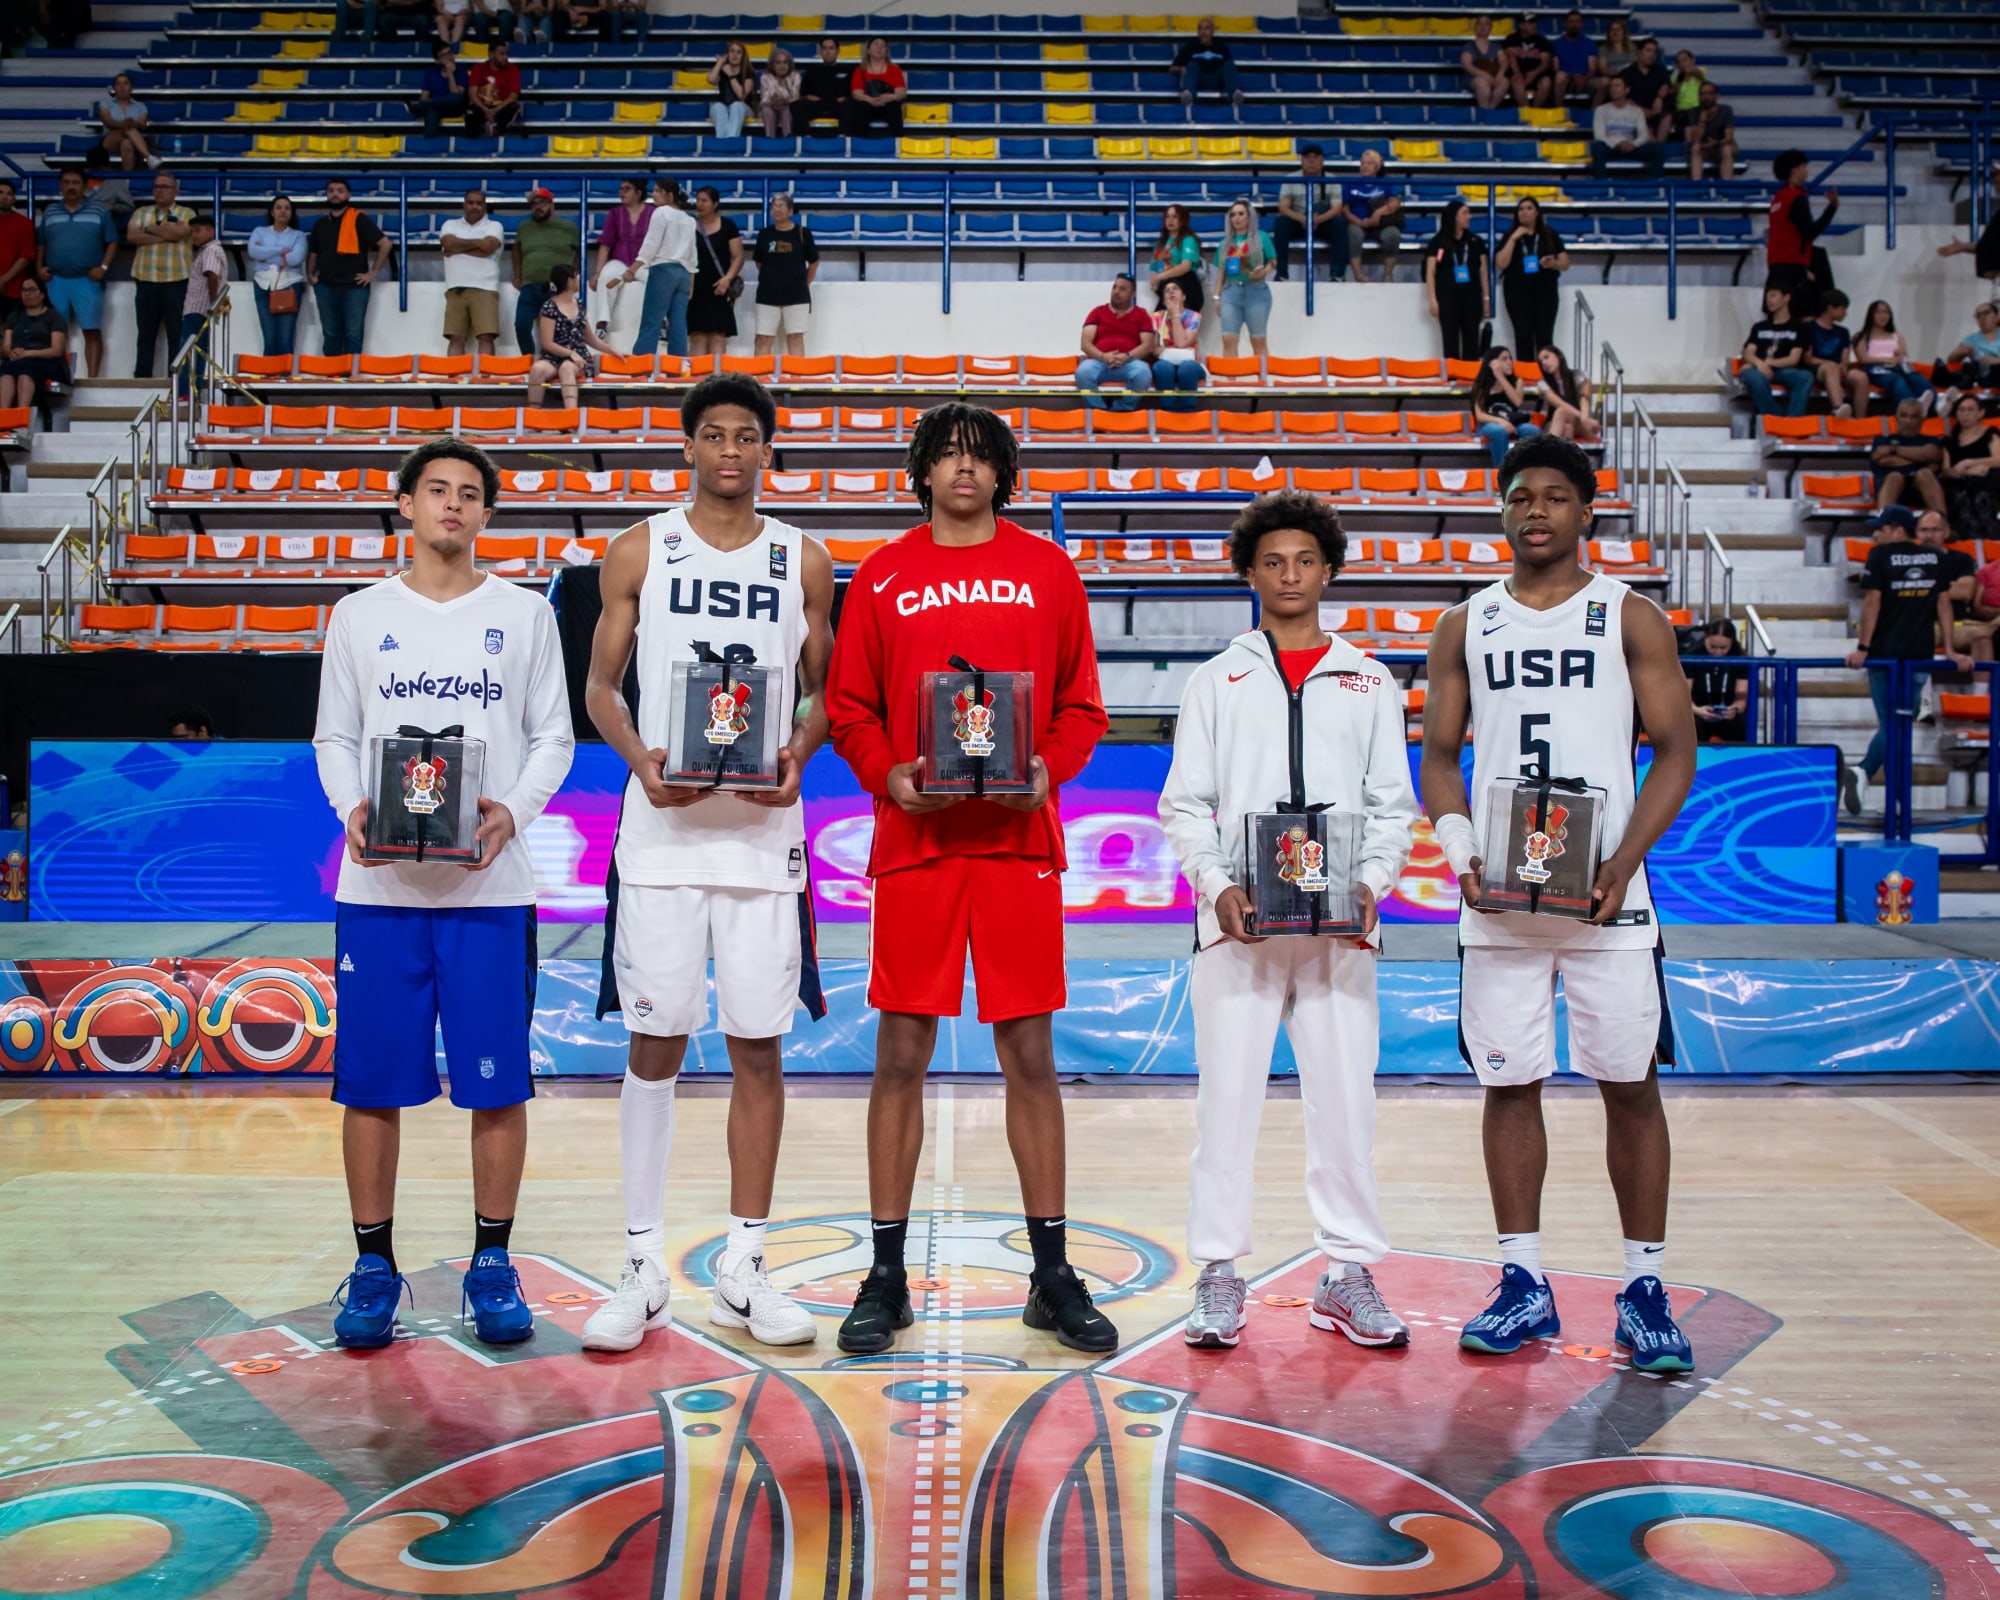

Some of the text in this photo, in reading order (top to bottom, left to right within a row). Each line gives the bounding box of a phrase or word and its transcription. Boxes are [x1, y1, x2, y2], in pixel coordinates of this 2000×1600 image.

[771, 562, 785, 572] FIBA
[669, 577, 780, 623] USA
[896, 579, 1035, 617] CANADA
[1588, 619, 1602, 628] FIBA
[1484, 649, 1596, 691] USA
[1339, 680, 1369, 693] RICO
[1520, 712, 1551, 777] 5
[241, 1361, 274, 1371] 5
